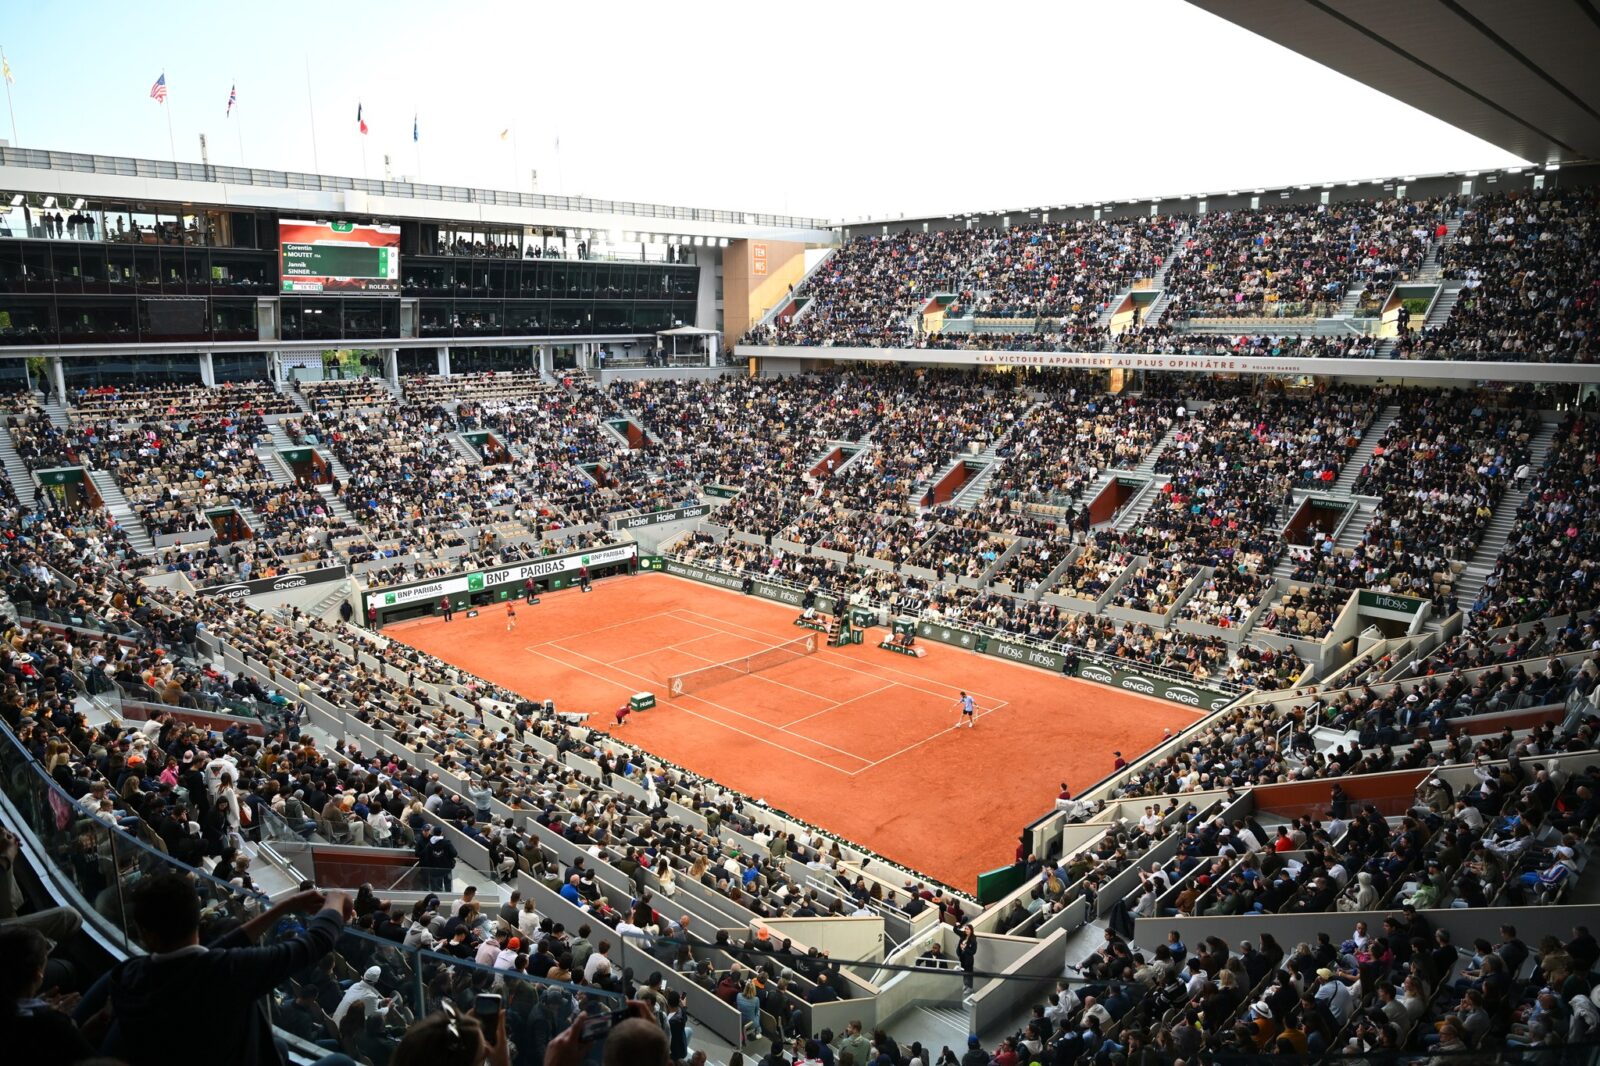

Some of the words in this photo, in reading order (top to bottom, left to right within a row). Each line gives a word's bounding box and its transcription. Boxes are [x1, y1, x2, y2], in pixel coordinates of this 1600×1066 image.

[999, 356, 1044, 364] VICTOIRE
[1049, 358, 1113, 366] APPARTIENT
[1169, 359, 1236, 369] OPINIÂTRE
[628, 517, 649, 527] Haier
[656, 512, 677, 522] Haier
[683, 507, 703, 518] Haier
[603, 549, 625, 559] PARIBAS
[486, 571, 510, 585] BNP
[520, 560, 565, 578] PARIBAS
[667, 564, 686, 575] Emirates
[705, 573, 726, 585] Emirates
[397, 590, 413, 599] BNP
[413, 584, 443, 596] PARIBAS
[1376, 595, 1408, 610] Infosys
[998, 643, 1024, 659] Infosys
[1029, 651, 1056, 667] Infosys
[640, 699, 654, 708] Haier
[878, 933, 883, 942] 2
